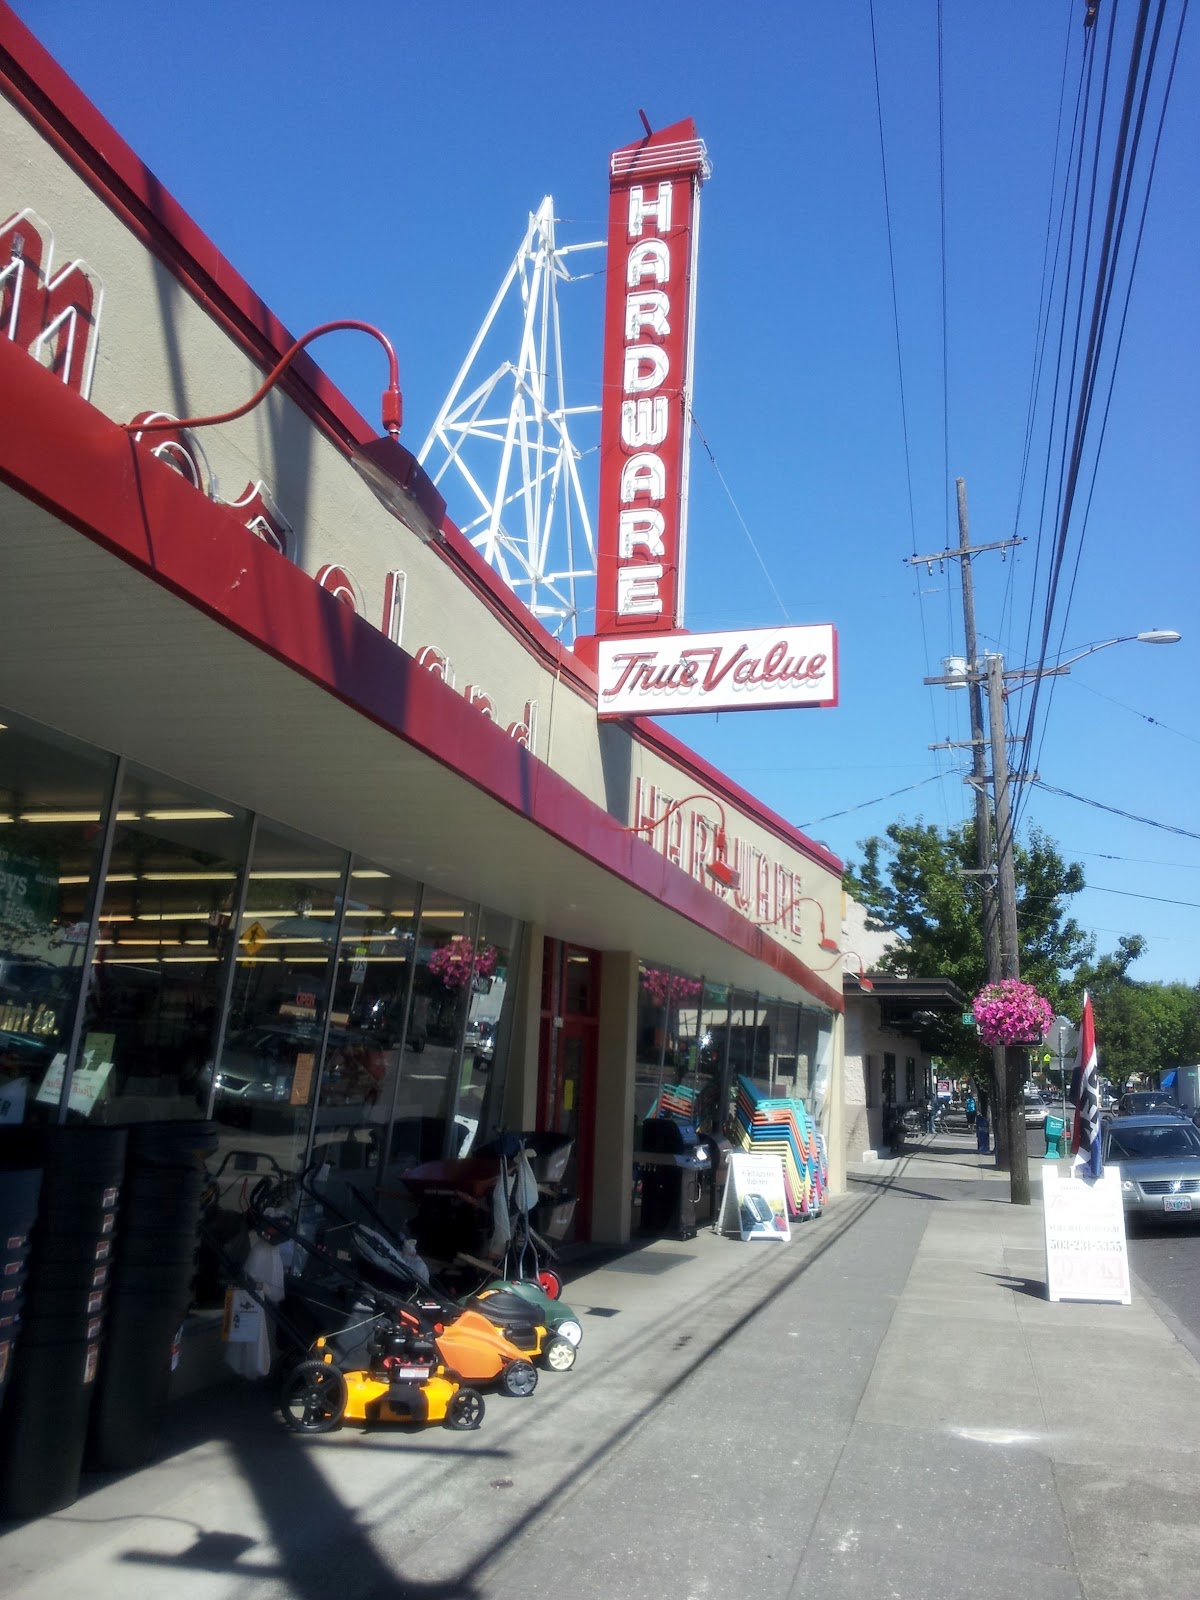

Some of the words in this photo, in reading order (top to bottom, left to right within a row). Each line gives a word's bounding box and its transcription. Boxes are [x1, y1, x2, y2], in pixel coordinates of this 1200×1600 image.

[617, 181, 673, 617] HARDWARE
[602, 651, 699, 696] True
[678, 640, 828, 693] Value
[964, 1015, 972, 1023] SE
